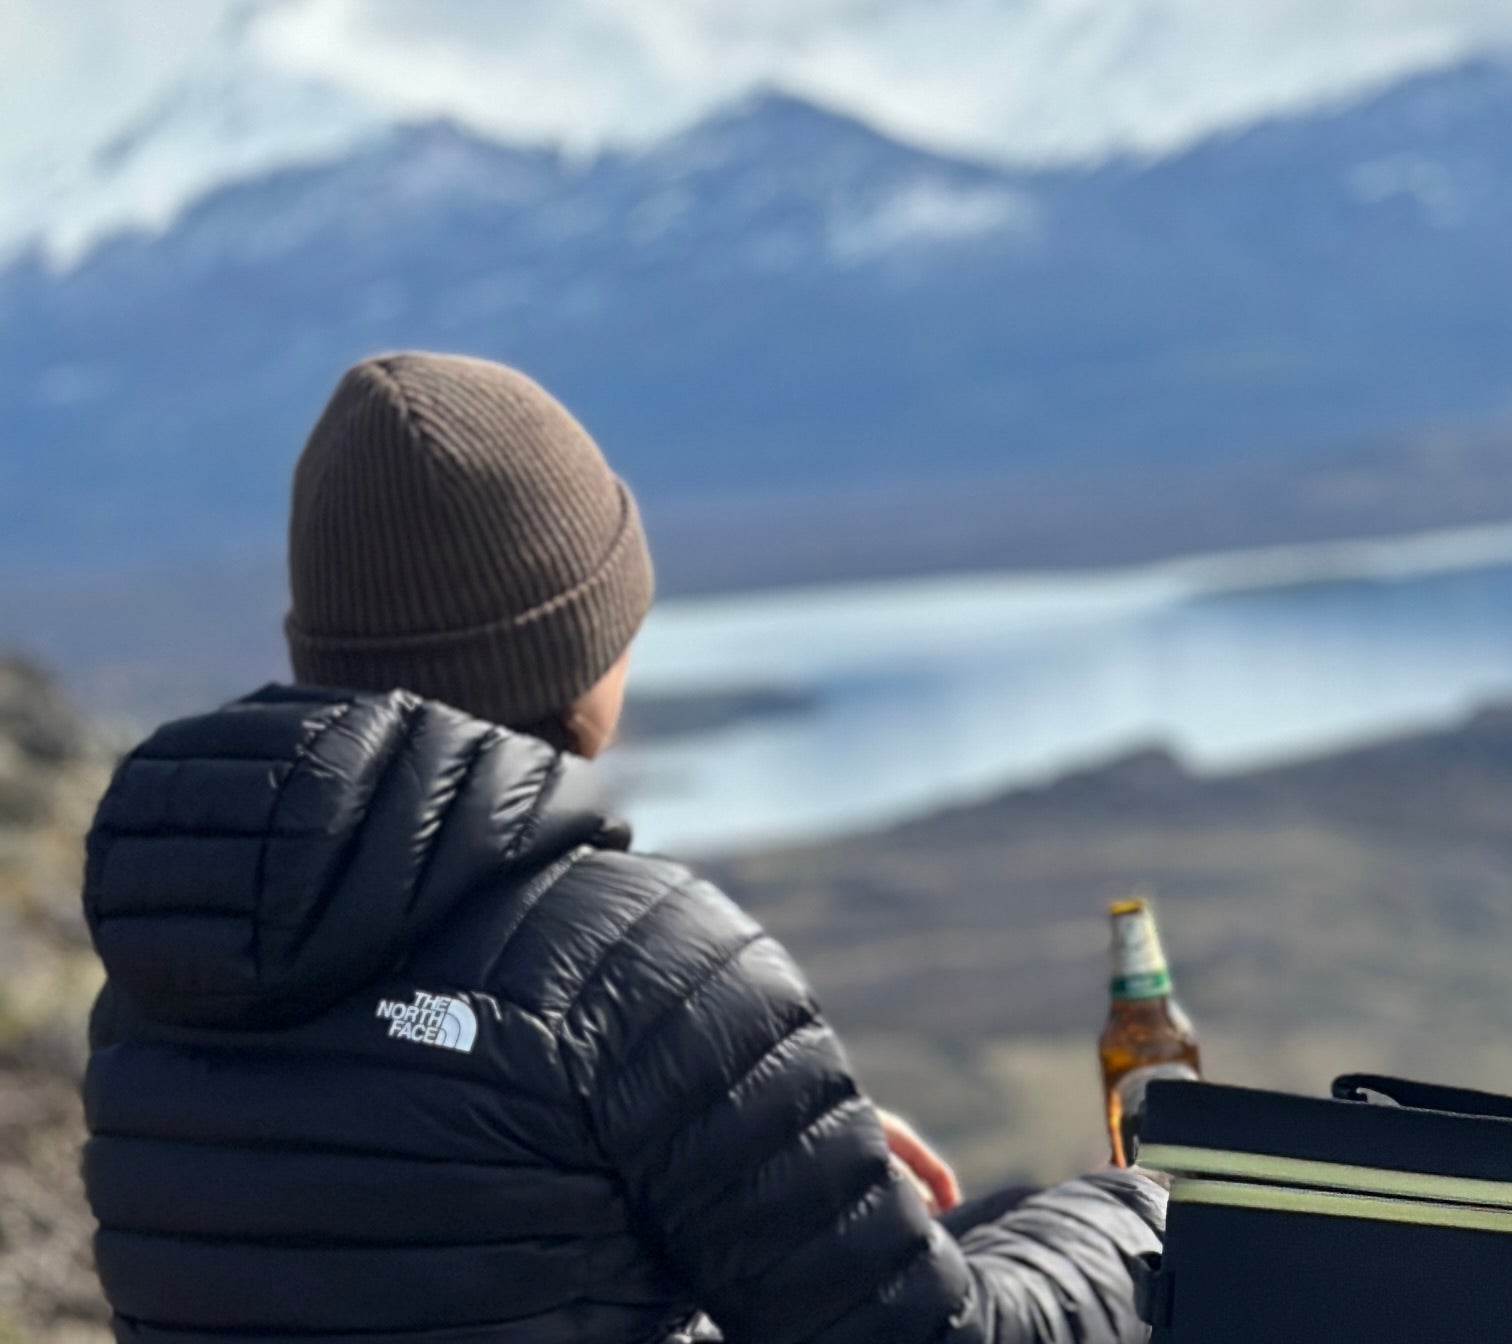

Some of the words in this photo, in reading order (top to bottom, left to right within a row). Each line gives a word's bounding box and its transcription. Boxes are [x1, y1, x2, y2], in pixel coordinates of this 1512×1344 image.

[414, 991, 451, 1012] THE
[376, 1000, 445, 1028] NORTH
[387, 1019, 439, 1043] FACE
